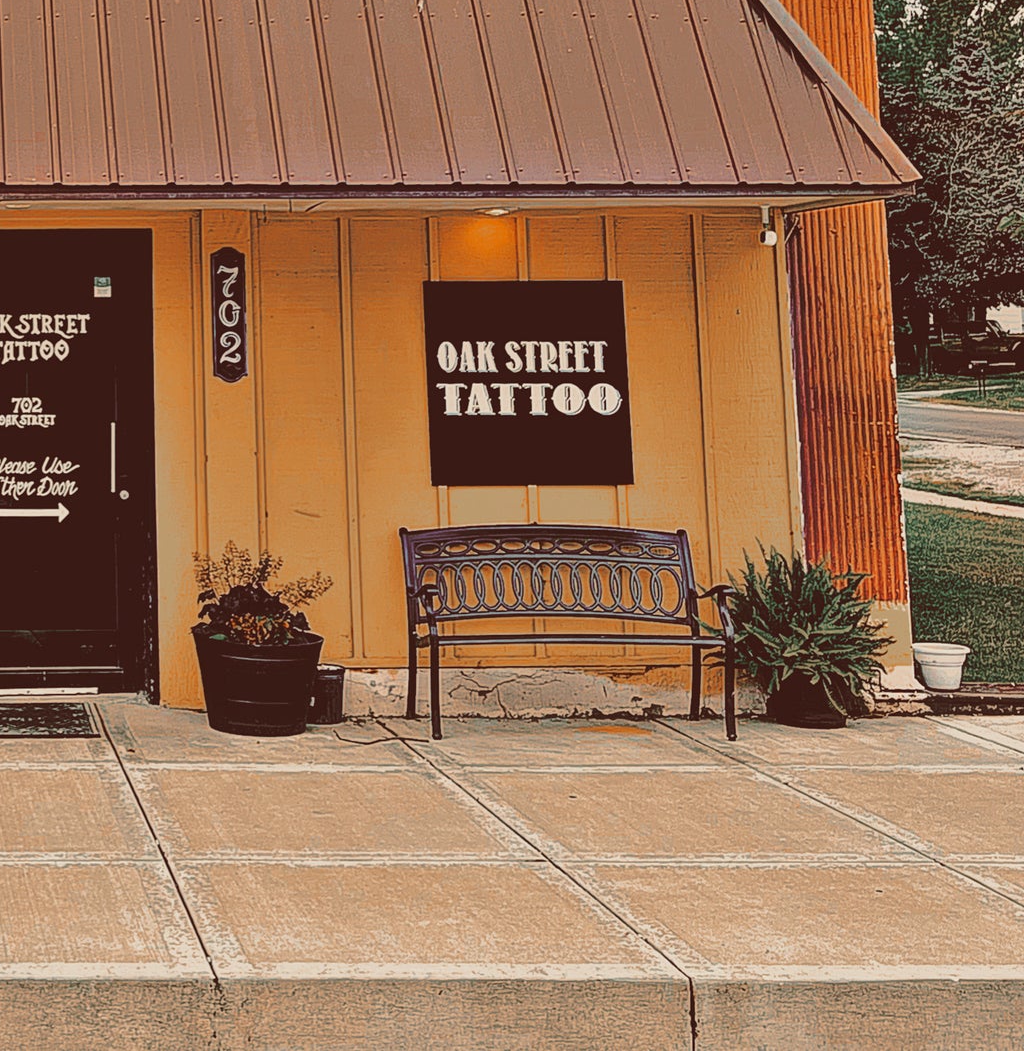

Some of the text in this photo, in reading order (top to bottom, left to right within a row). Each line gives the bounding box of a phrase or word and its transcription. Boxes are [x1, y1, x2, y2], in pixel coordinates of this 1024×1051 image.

[217, 265, 242, 364] 702
[14, 314, 91, 340] STREET
[436, 341, 608, 374] OAK STREET
[11, 397, 43, 414] 702
[436, 382, 623, 417] TATTOO
[19, 414, 56, 428] STREET
[41, 456, 80, 475] Use
[36, 476, 79, 497] Door
